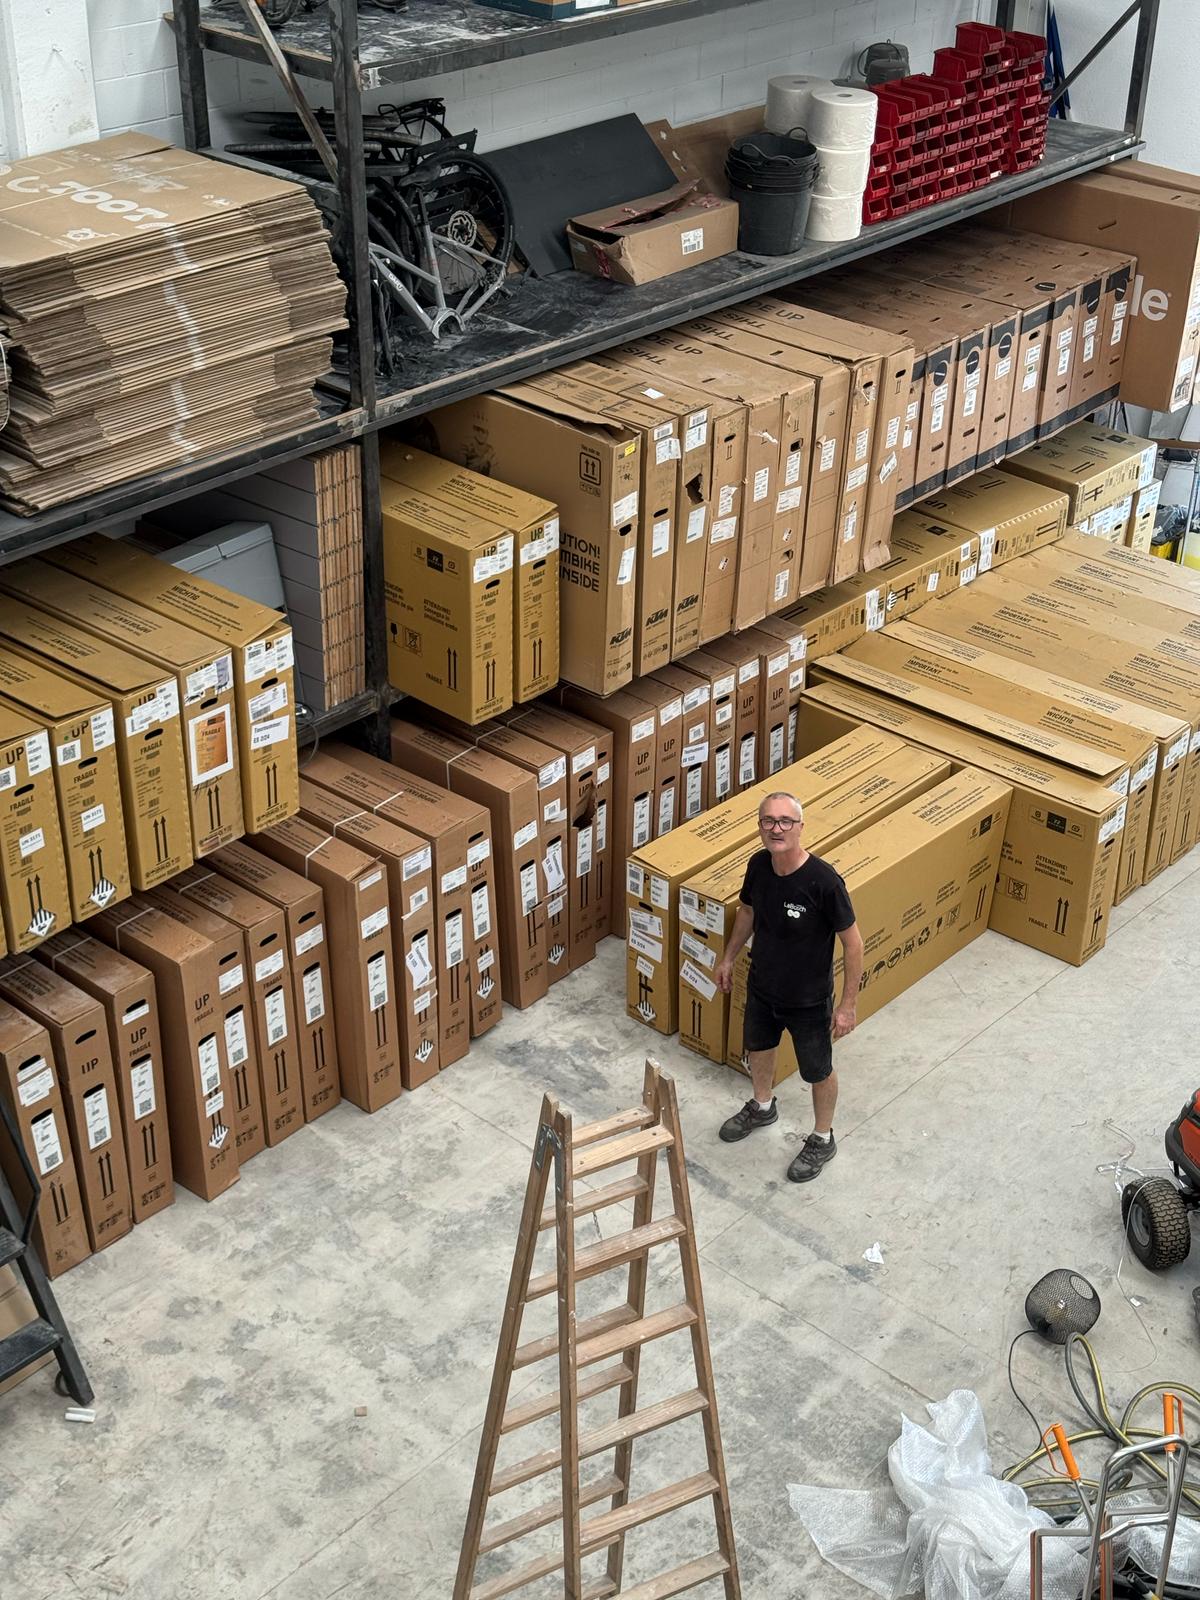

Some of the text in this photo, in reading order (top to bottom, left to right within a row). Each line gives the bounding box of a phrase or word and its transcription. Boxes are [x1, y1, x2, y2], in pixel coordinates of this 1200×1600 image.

[723, 312, 767, 329] THIS
[775, 309, 805, 321] UP
[690, 322, 735, 341] THIS
[623, 346, 667, 366] THIS
[673, 343, 703, 356] UP
[559, 532, 600, 559] UTION!
[528, 570, 545, 582] FRAGILE
[559, 566, 600, 592] INSIDE
[1081, 565, 1113, 579] IMPORTANT
[171, 585, 201, 601] WICHTIG
[1055, 579, 1088, 592] IMPORTANT
[481, 589, 499, 601] FRAGILE
[1027, 594, 1060, 609] IMPORTANT
[677, 595, 699, 612] KTM
[646, 608, 669, 627] KTM
[999, 609, 1032, 624] IMPORTANT
[610, 628, 632, 646] KTM
[971, 624, 1006, 640] IMPORTANT
[907, 659, 943, 675] IMPORTANT
[1134, 656, 1161, 669] WICHTIG
[1108, 674, 1136, 687] WICHTIG
[743, 695, 754, 709] UP
[772, 687, 783, 701] UP
[1081, 696, 1119, 712] IMPORTANT
[1046, 710, 1075, 725] WICHTIG
[71, 720, 89, 738] UP
[140, 739, 163, 755] FRAGILE
[663, 738, 675, 753] UP
[1018, 731, 1056, 748] IMPORTANT
[5, 746, 24, 765] UP
[637, 752, 649, 766] UP
[73, 767, 98, 785] FRAGILE
[1012, 765, 1051, 783] IMPORTANT
[10, 795, 34, 812] FRAGILE
[695, 818, 729, 839] IMPORTANT
[470, 871, 488, 884] FRAGILE
[1028, 917, 1049, 929] FRAGILE
[263, 975, 282, 990] FRAGILE
[194, 993, 210, 1011] UP
[194, 1007, 214, 1024] FRAGILE
[131, 1026, 147, 1045] UP
[129, 1042, 151, 1057] FRAGILE
